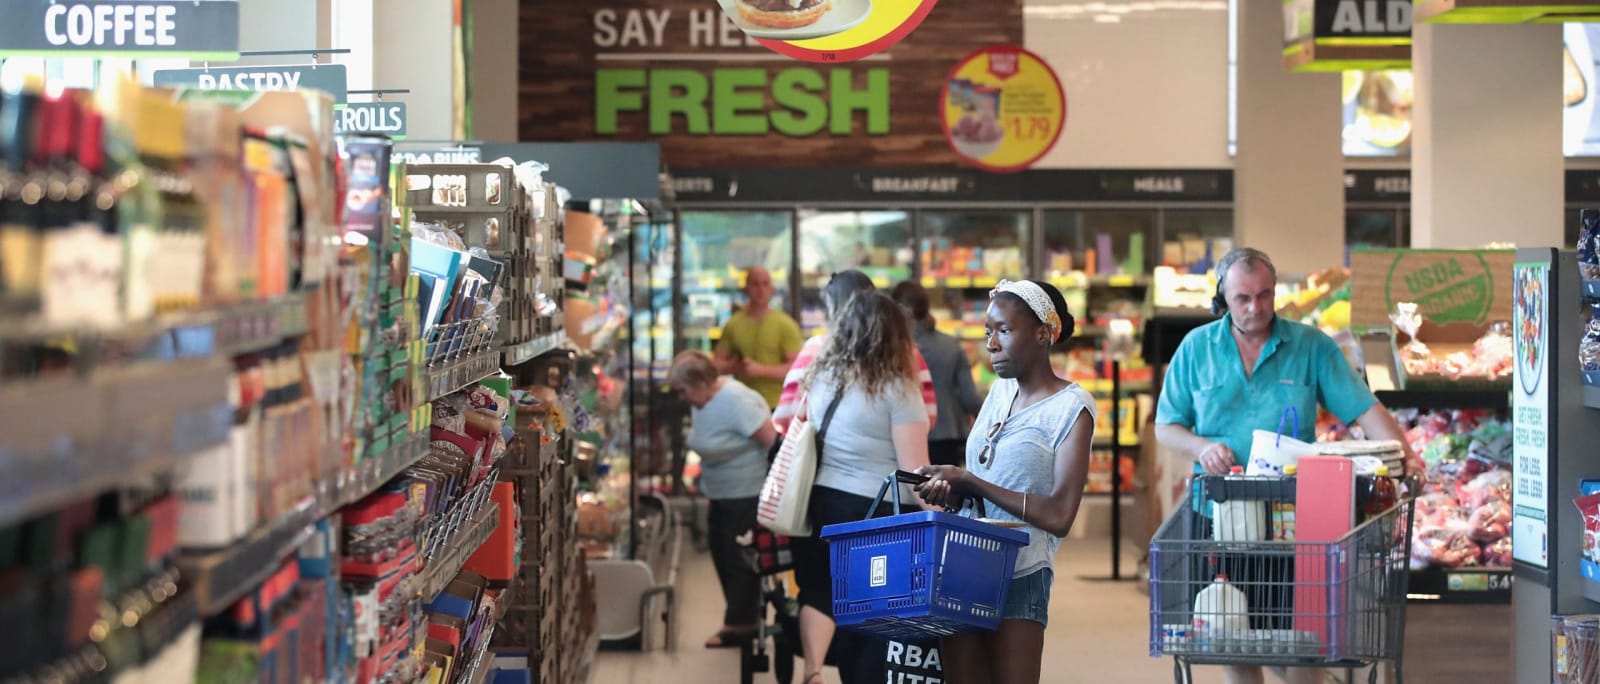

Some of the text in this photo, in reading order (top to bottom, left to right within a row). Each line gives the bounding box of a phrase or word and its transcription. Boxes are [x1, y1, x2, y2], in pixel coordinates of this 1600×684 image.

[44, 4, 176, 46] COFFEE
[593, 9, 671, 47] SAY
[342, 107, 402, 131] ROLLS
[595, 68, 890, 135] FRESH
[872, 176, 958, 192] BREAKFAST
[1134, 176, 1184, 192] MEALS
[1404, 256, 1465, 295] USDA
